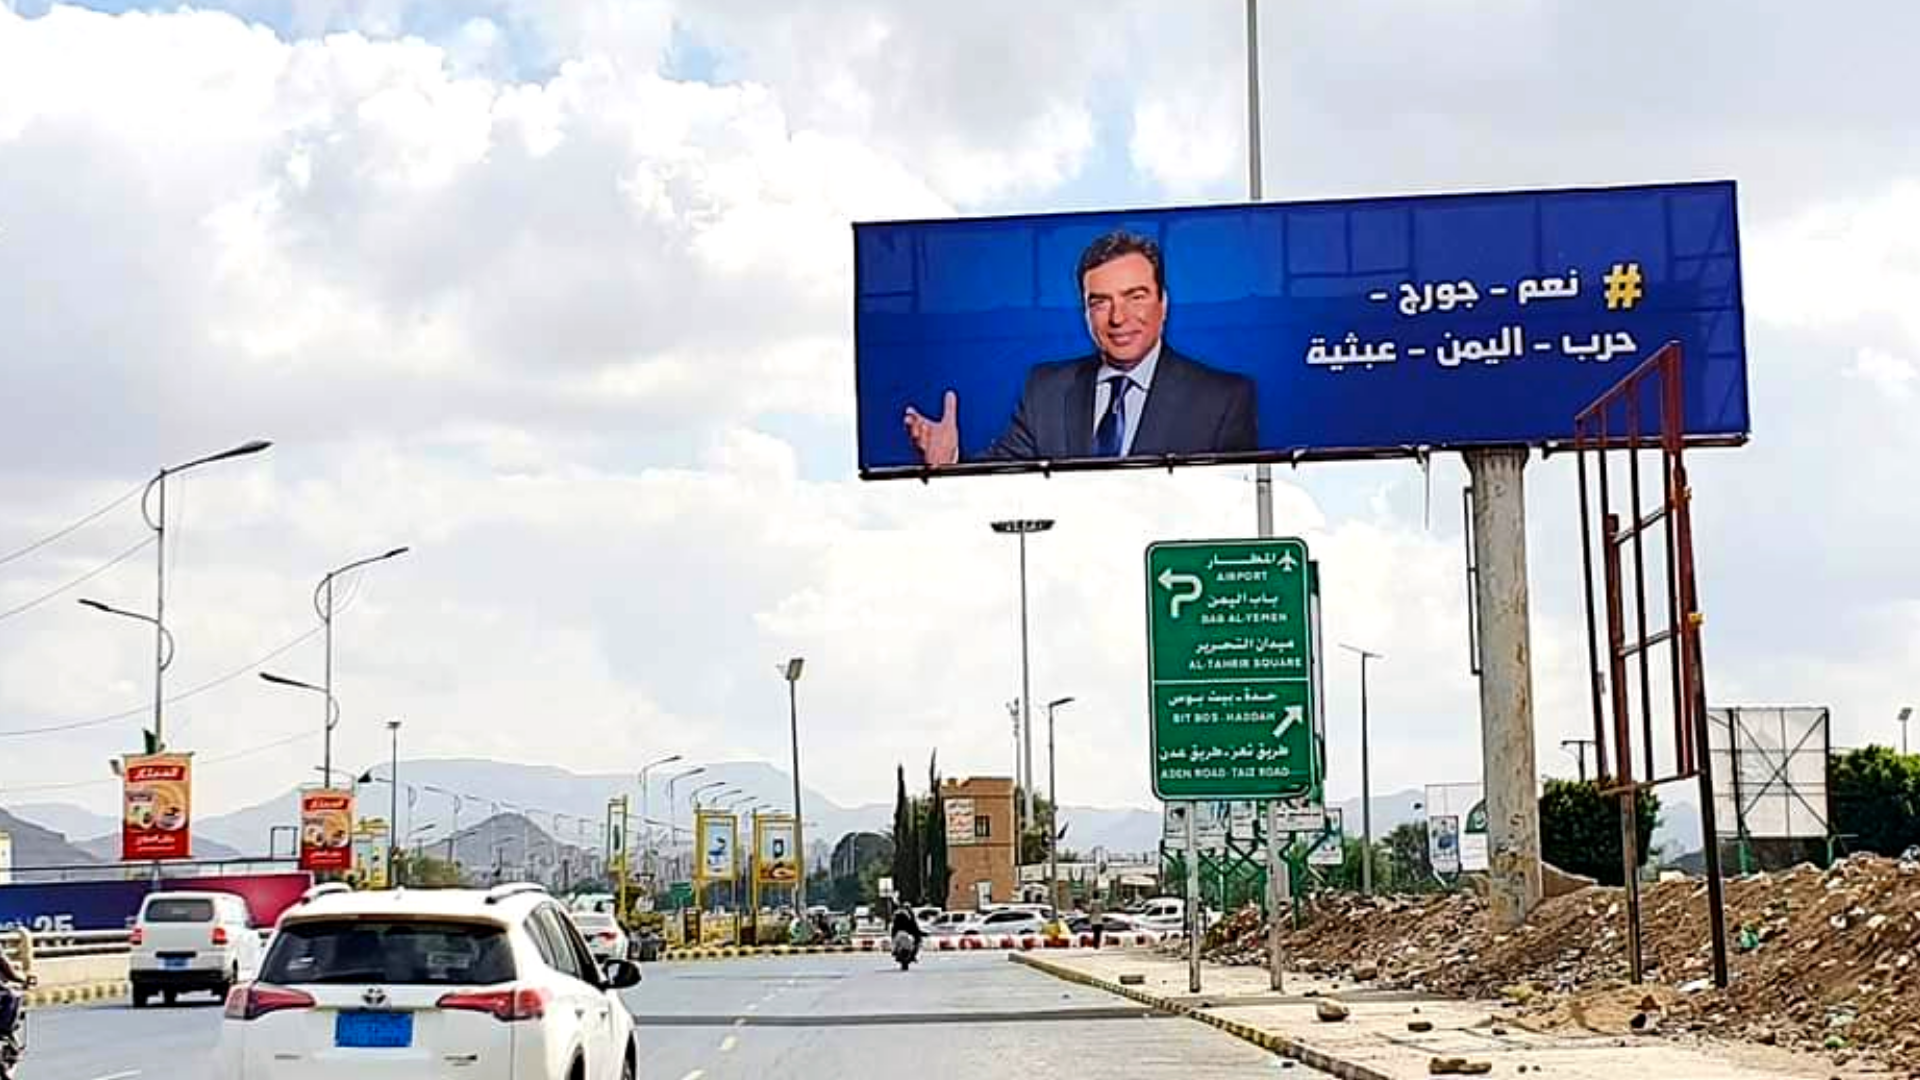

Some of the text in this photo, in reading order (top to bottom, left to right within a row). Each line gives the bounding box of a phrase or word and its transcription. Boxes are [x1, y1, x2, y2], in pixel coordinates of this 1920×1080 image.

[1517, 268, 1580, 305] نعم
[1399, 278, 1480, 314] جورج
[1305, 332, 1397, 371] عبثية
[1436, 326, 1523, 366] اليمن
[1561, 330, 1637, 362] حرب
[1216, 571, 1268, 582] AIRPORT
[1207, 591, 1279, 608] باب اليمن
[1228, 612, 1288, 624] AL-YEMEN
[1195, 637, 1294, 655] ميدان التحرير
[1254, 656, 1302, 669] SQUARE
[1172, 713, 1192, 724] BIT
[1194, 712, 1219, 723] BOS
[1158, 746, 1187, 761] عدن
[1255, 742, 1289, 761] طريق
[1160, 766, 1291, 780] ADEN ROAD TAIZ ROAD
